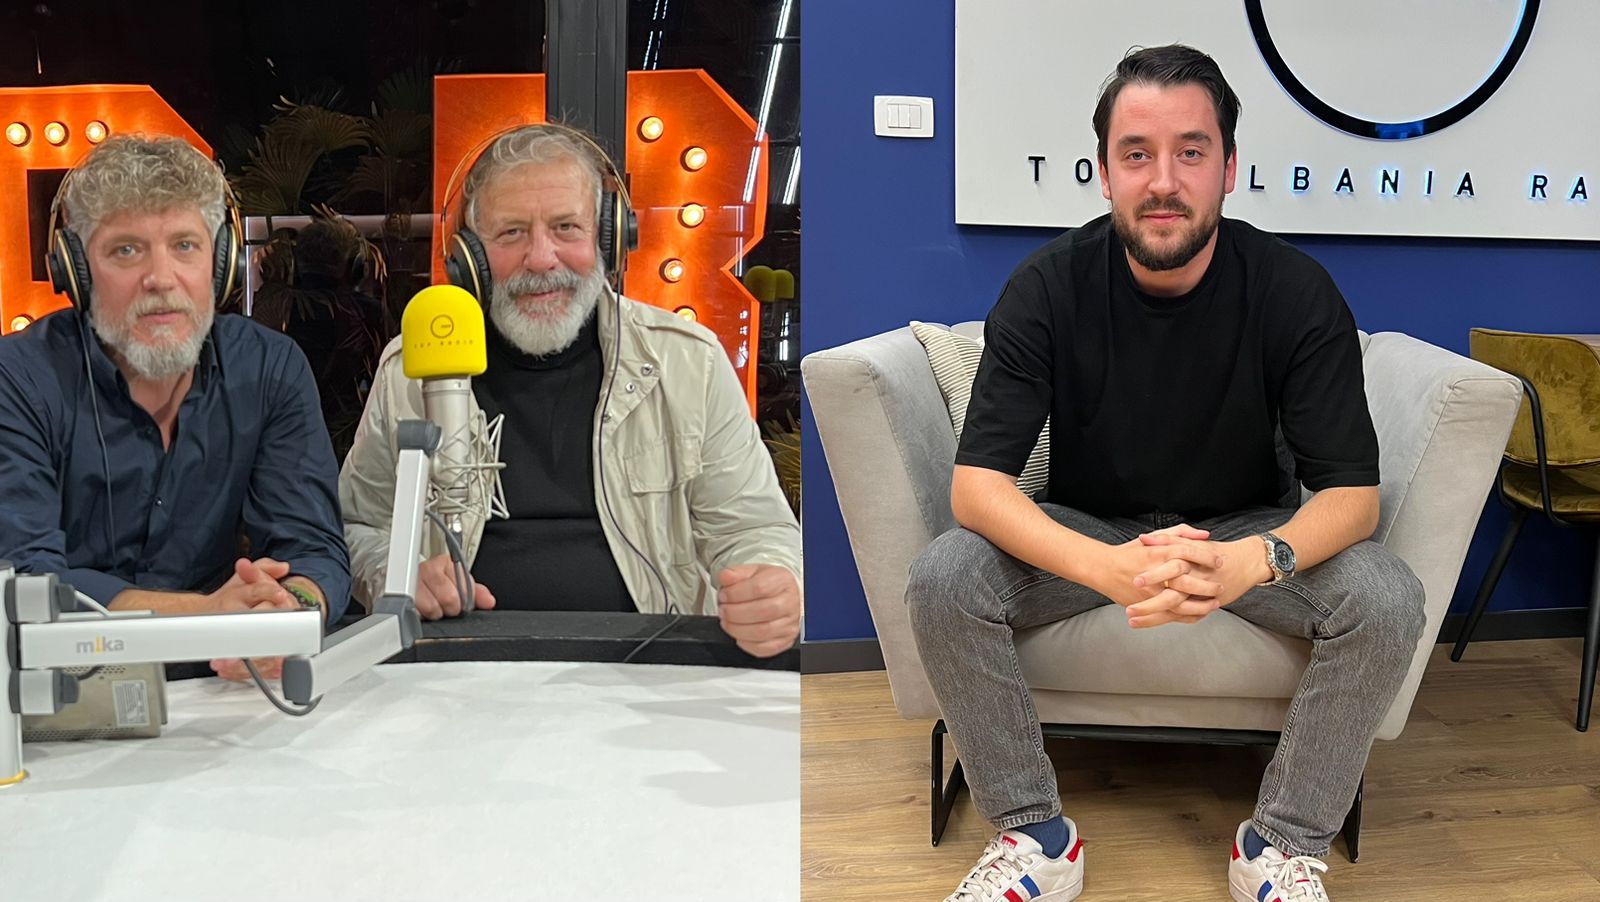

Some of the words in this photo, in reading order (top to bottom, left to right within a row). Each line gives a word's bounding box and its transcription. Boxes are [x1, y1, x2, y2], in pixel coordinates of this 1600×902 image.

[1027, 155, 1094, 184] TO
[1249, 164, 1475, 197] LBANIA
[76, 634, 125, 653] mika
